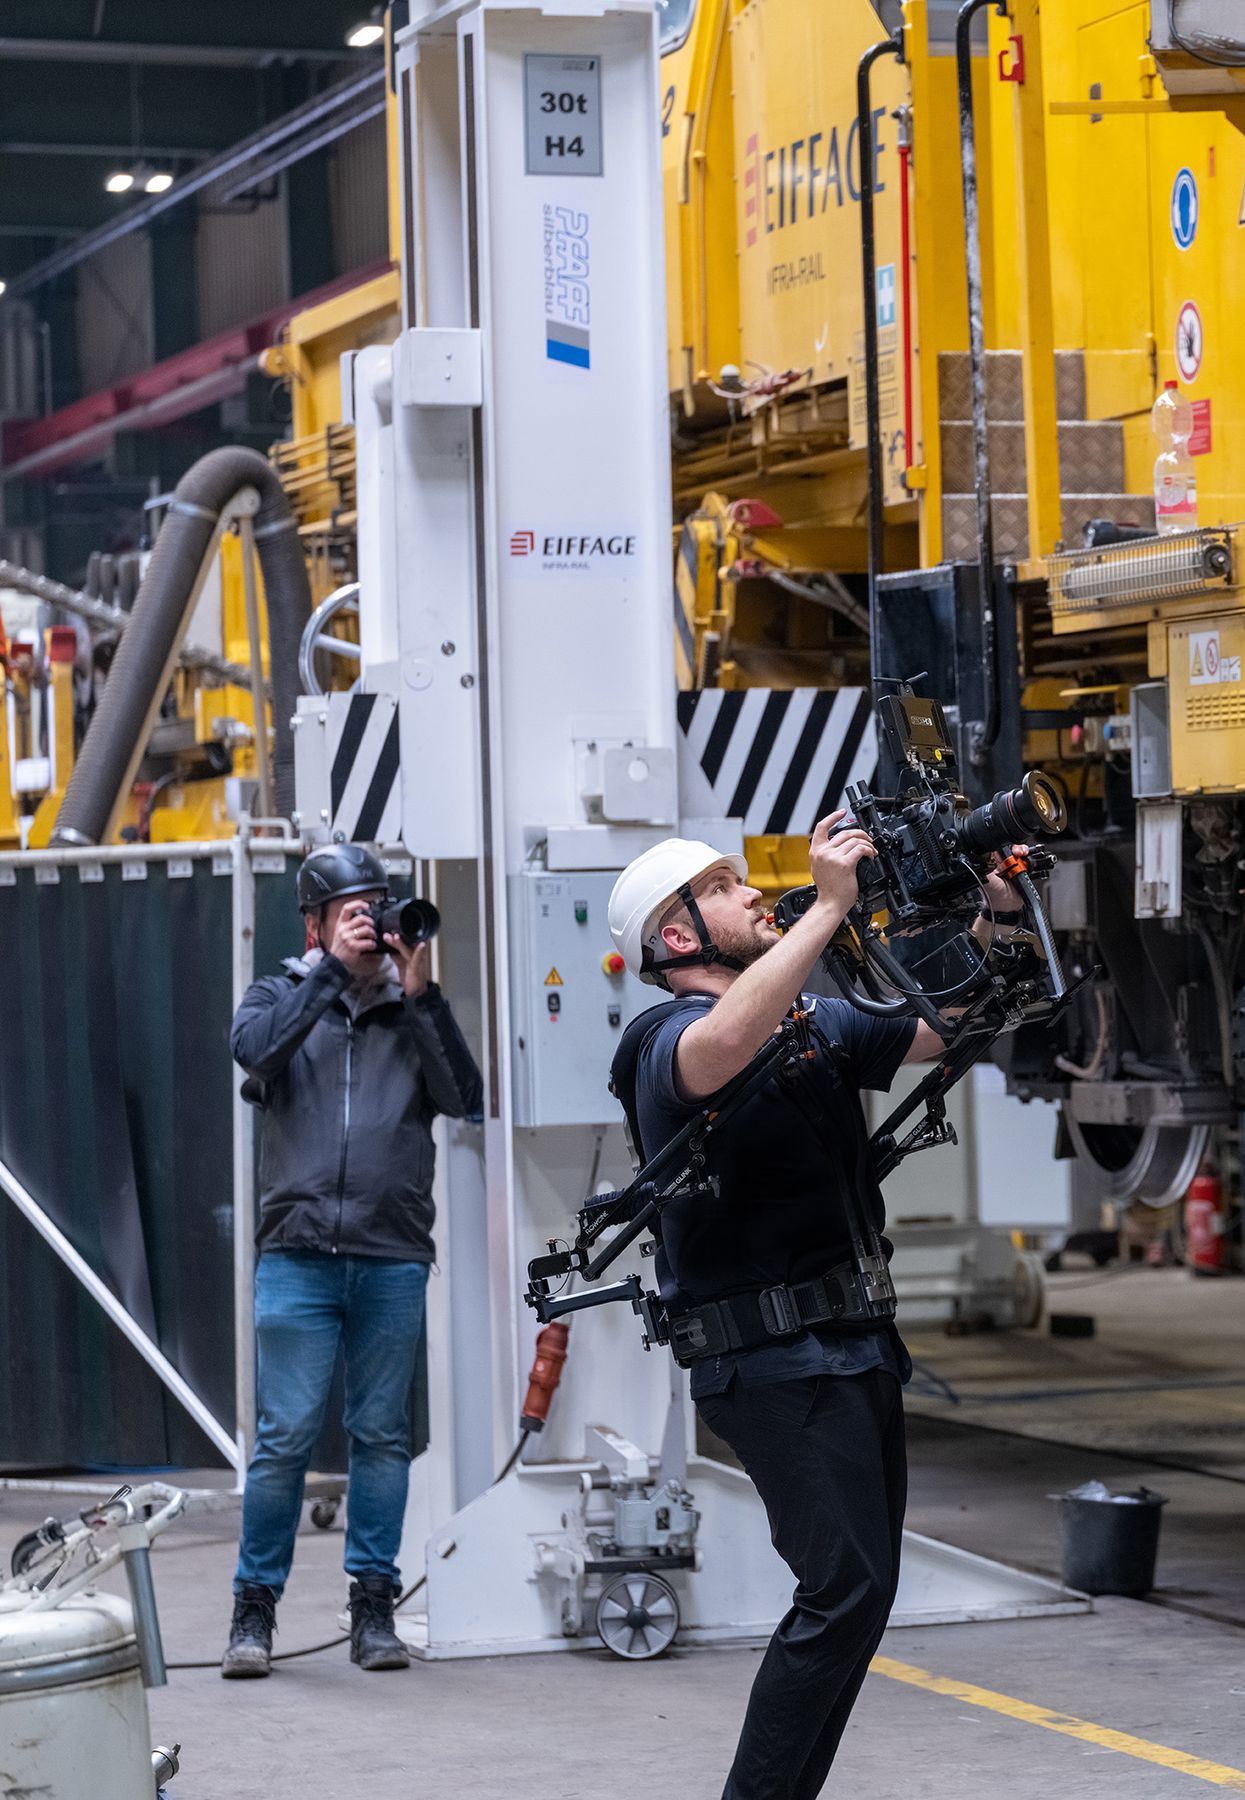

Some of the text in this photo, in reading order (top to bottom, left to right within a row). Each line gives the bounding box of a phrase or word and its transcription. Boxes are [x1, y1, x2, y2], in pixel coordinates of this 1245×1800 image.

[540, 91, 588, 115] 30t
[545, 135, 585, 158] H4
[543, 536, 636, 556] EIFFAGE
